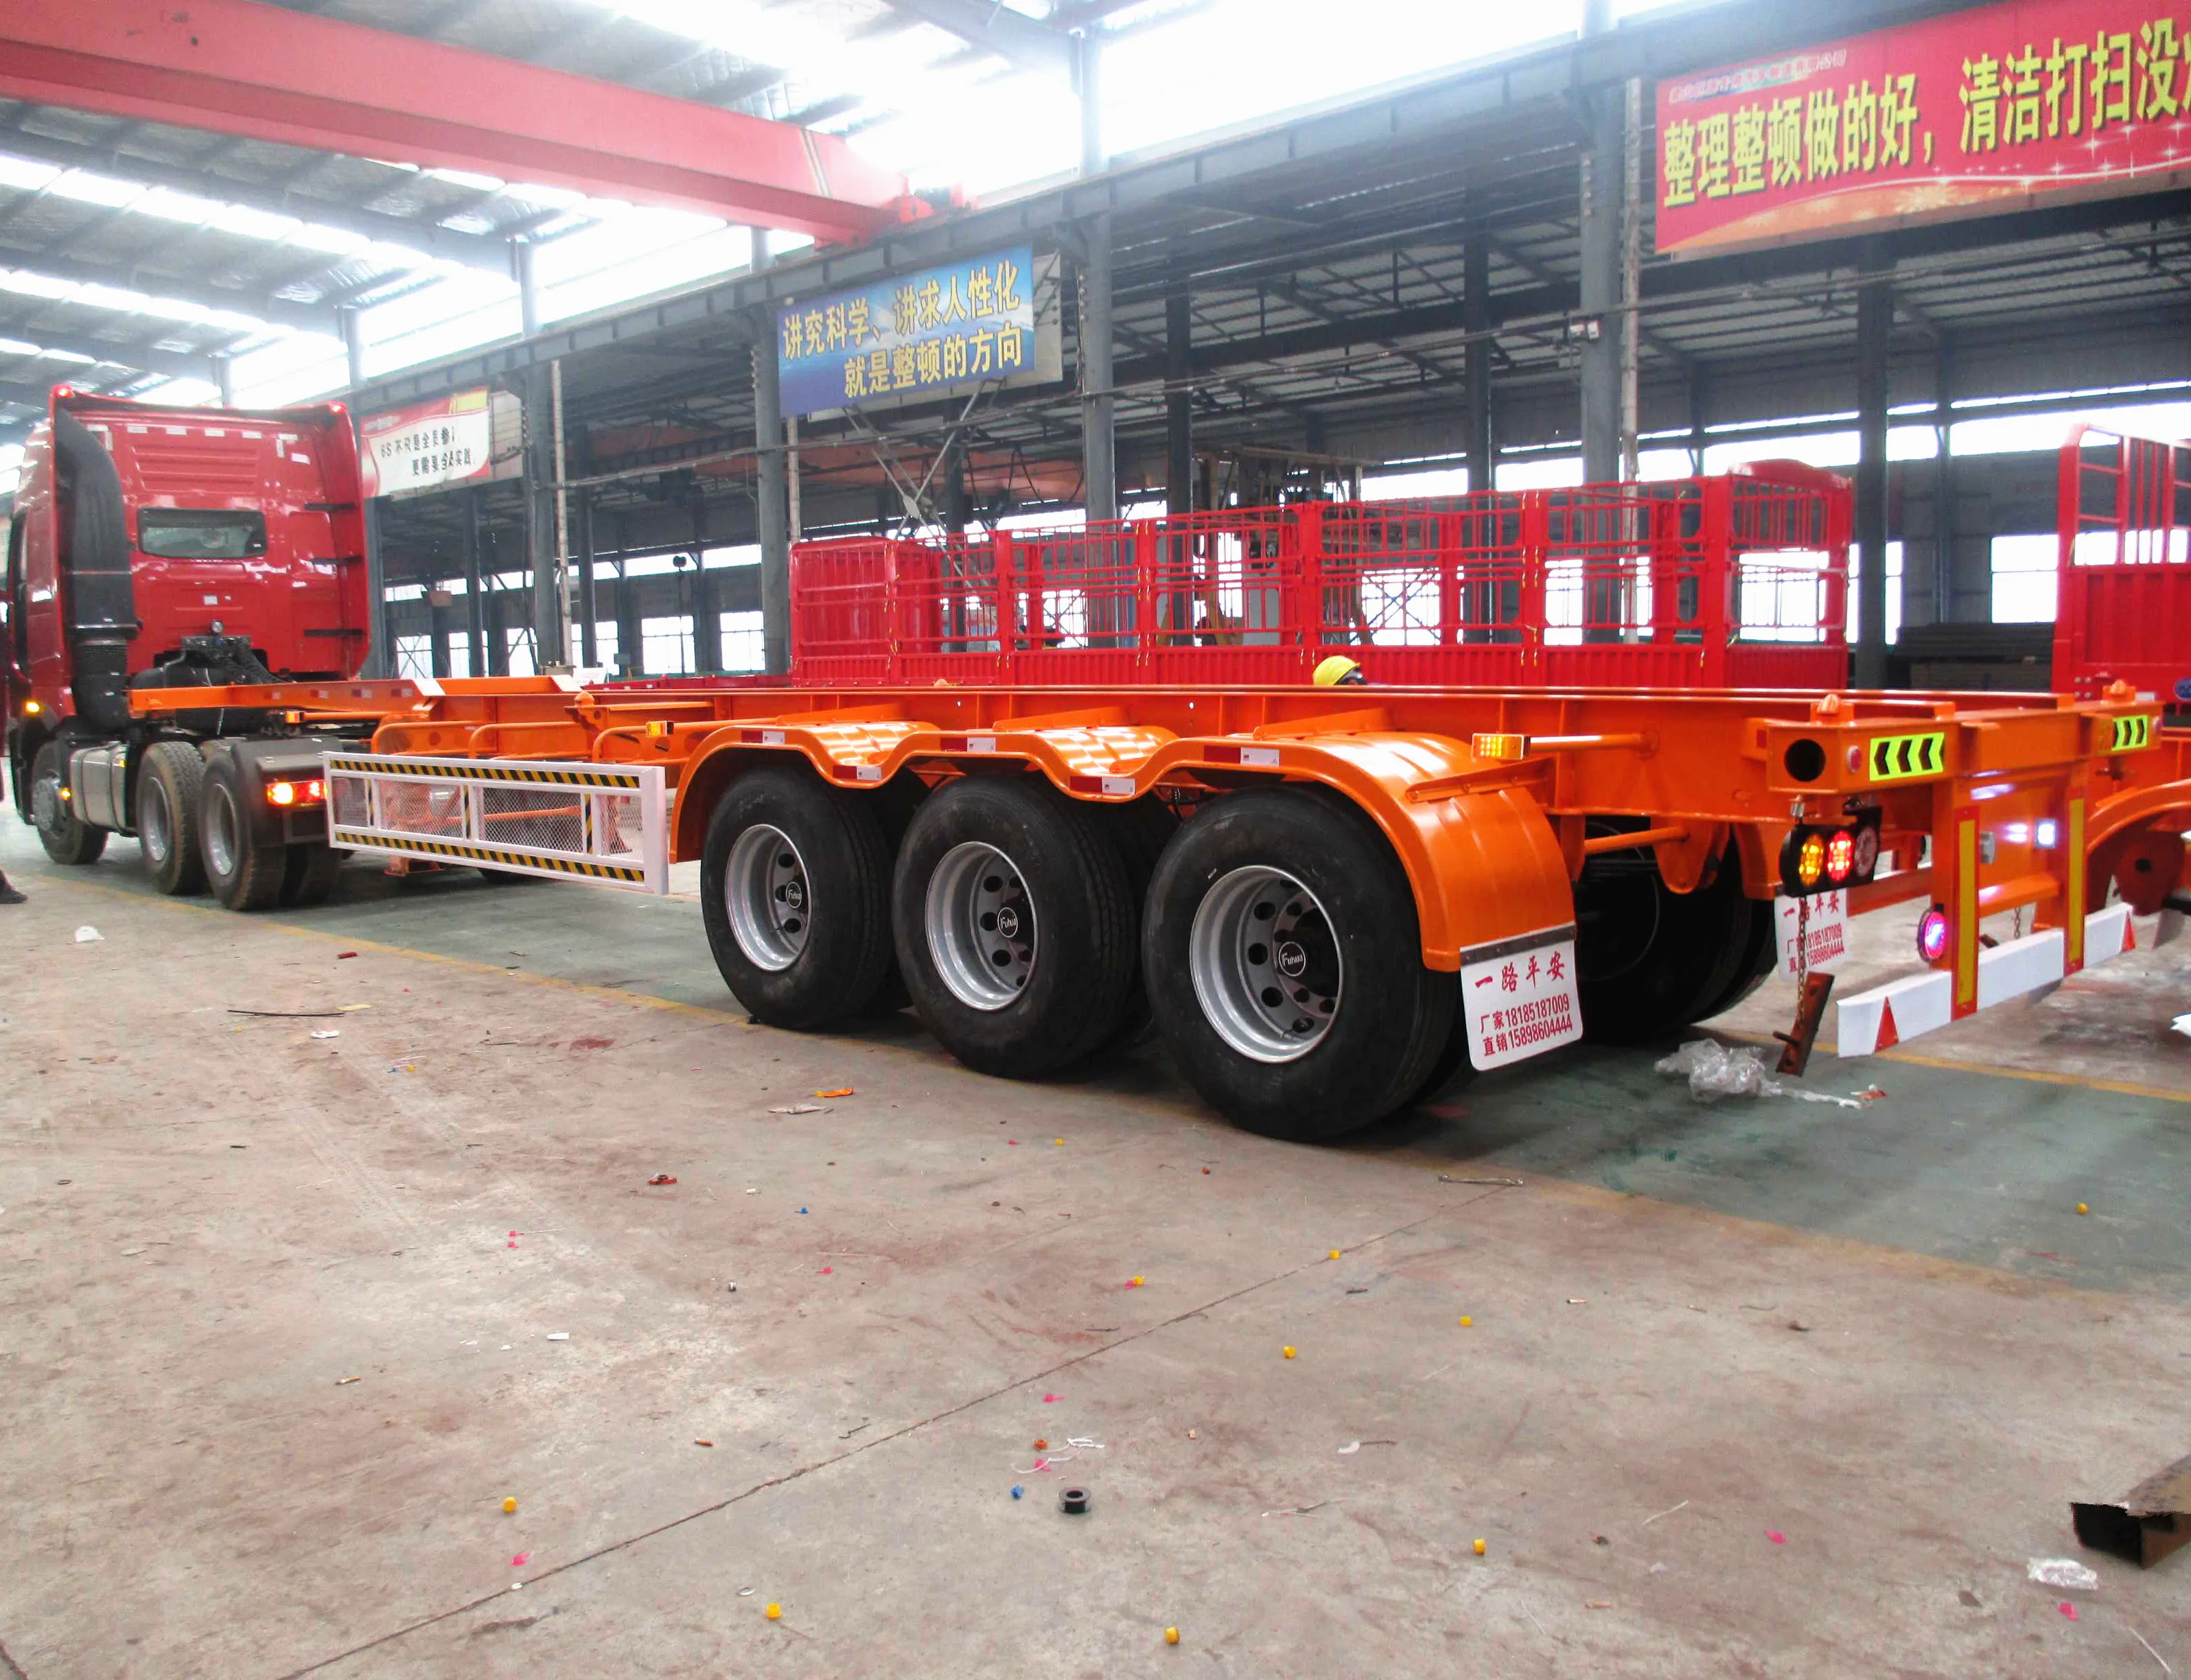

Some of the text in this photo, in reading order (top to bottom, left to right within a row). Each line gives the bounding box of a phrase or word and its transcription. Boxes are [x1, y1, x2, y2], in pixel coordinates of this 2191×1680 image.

[1663, 17, 2191, 208] 整理整顿做的好，清洁打扫没
[782, 258, 1021, 360] 讲究科学、讲求人性化
[844, 320, 1023, 399] 就是整顿的方向
[1281, 952, 1303, 967] Fuhua
[1475, 950, 1566, 993] 一路平安
